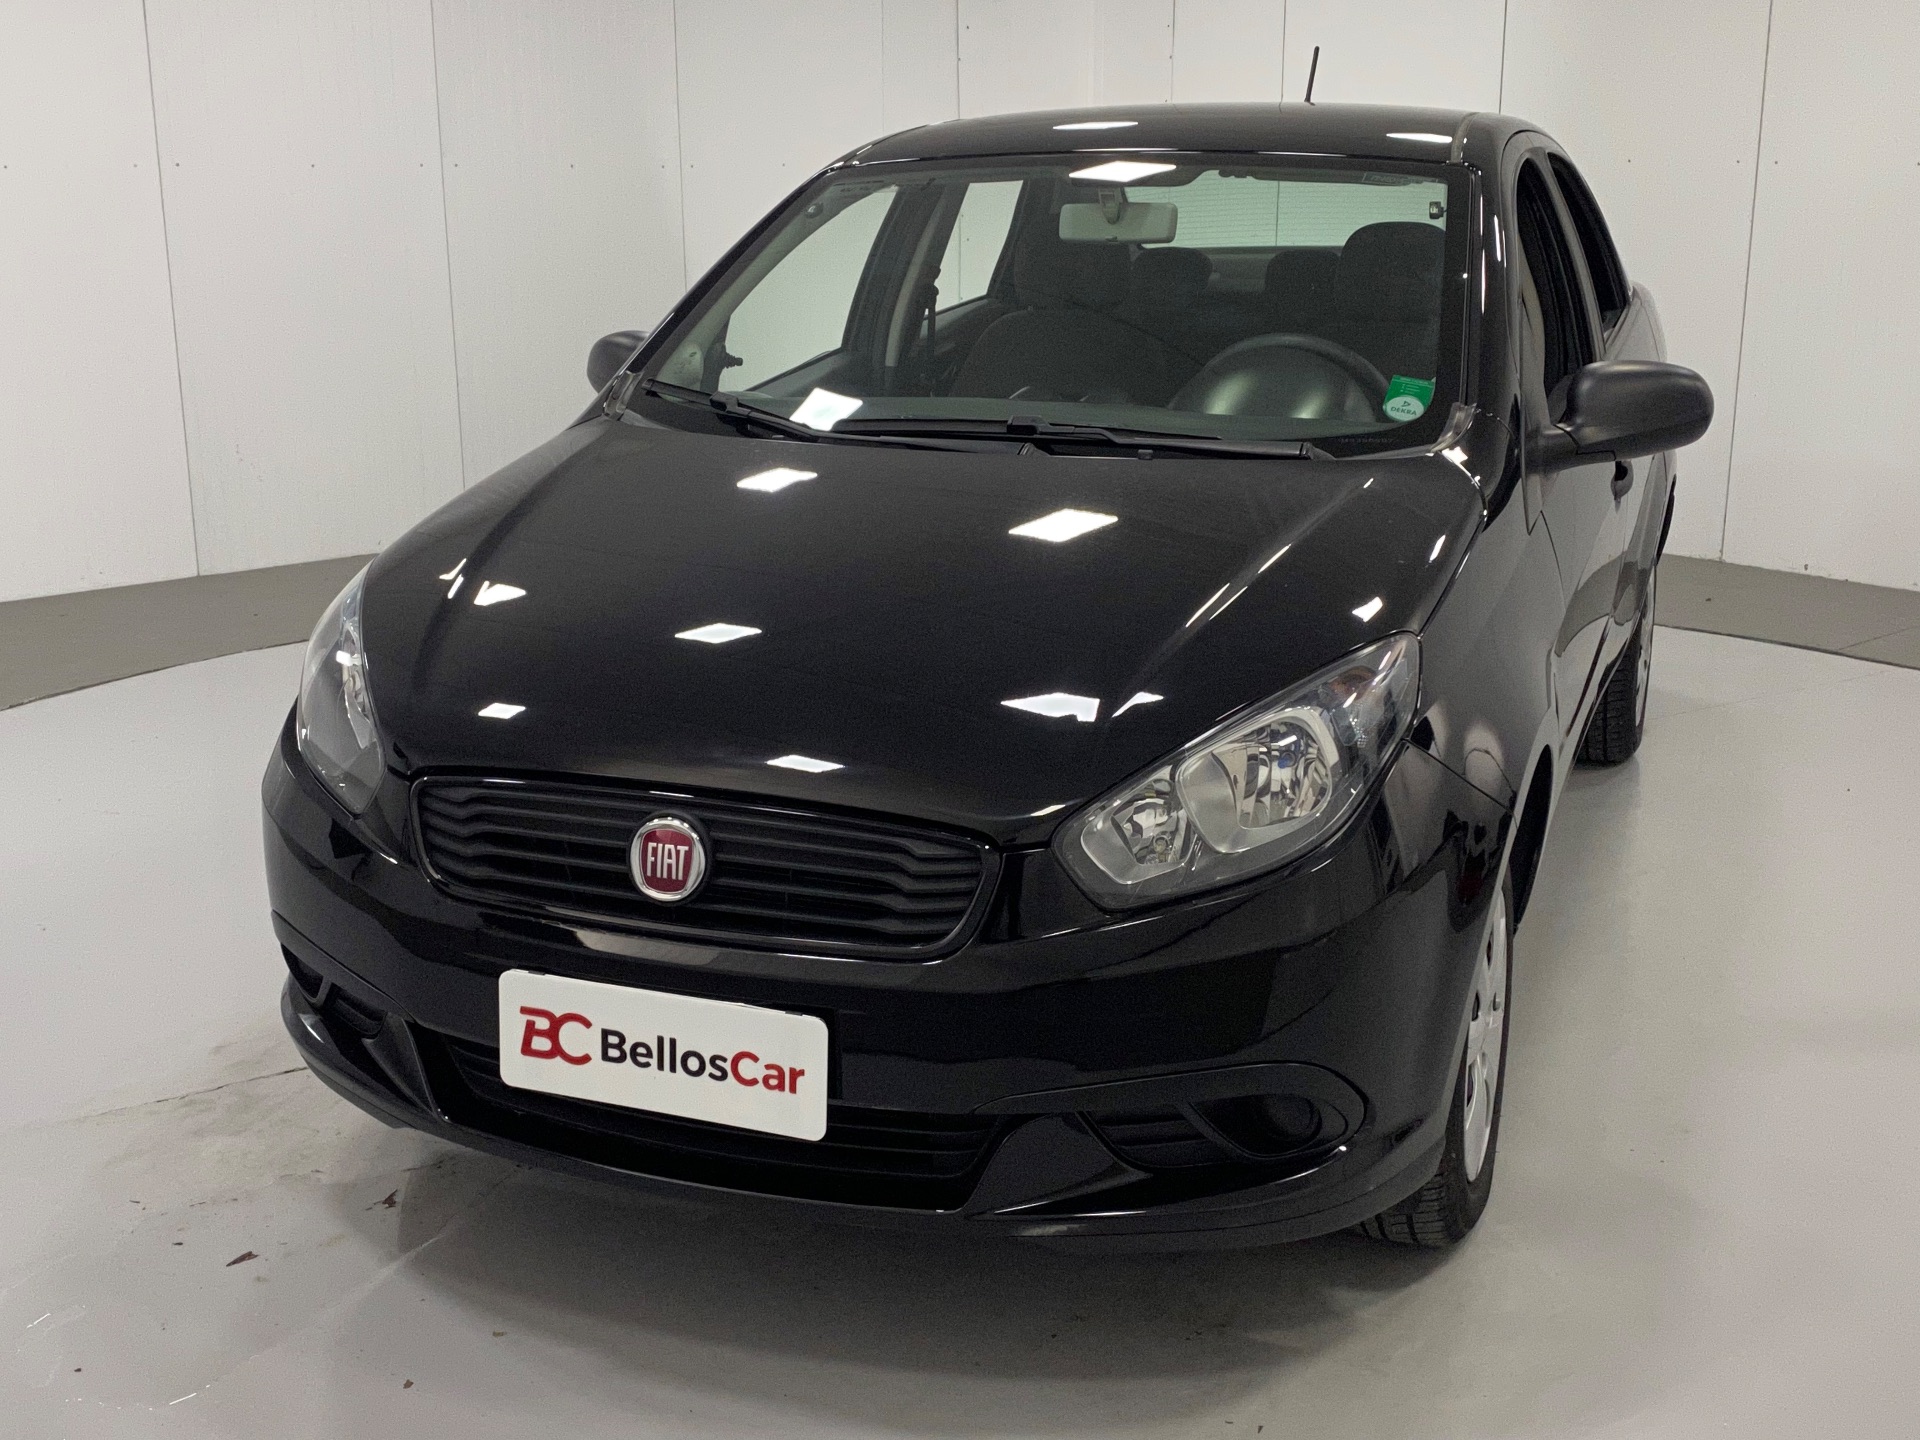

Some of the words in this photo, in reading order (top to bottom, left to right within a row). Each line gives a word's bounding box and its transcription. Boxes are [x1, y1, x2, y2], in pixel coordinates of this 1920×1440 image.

[1390, 406, 1417, 416] DEKRA
[646, 842, 689, 880] FIAT
[519, 1005, 592, 1066] BC
[600, 1027, 805, 1095] BellosCar
